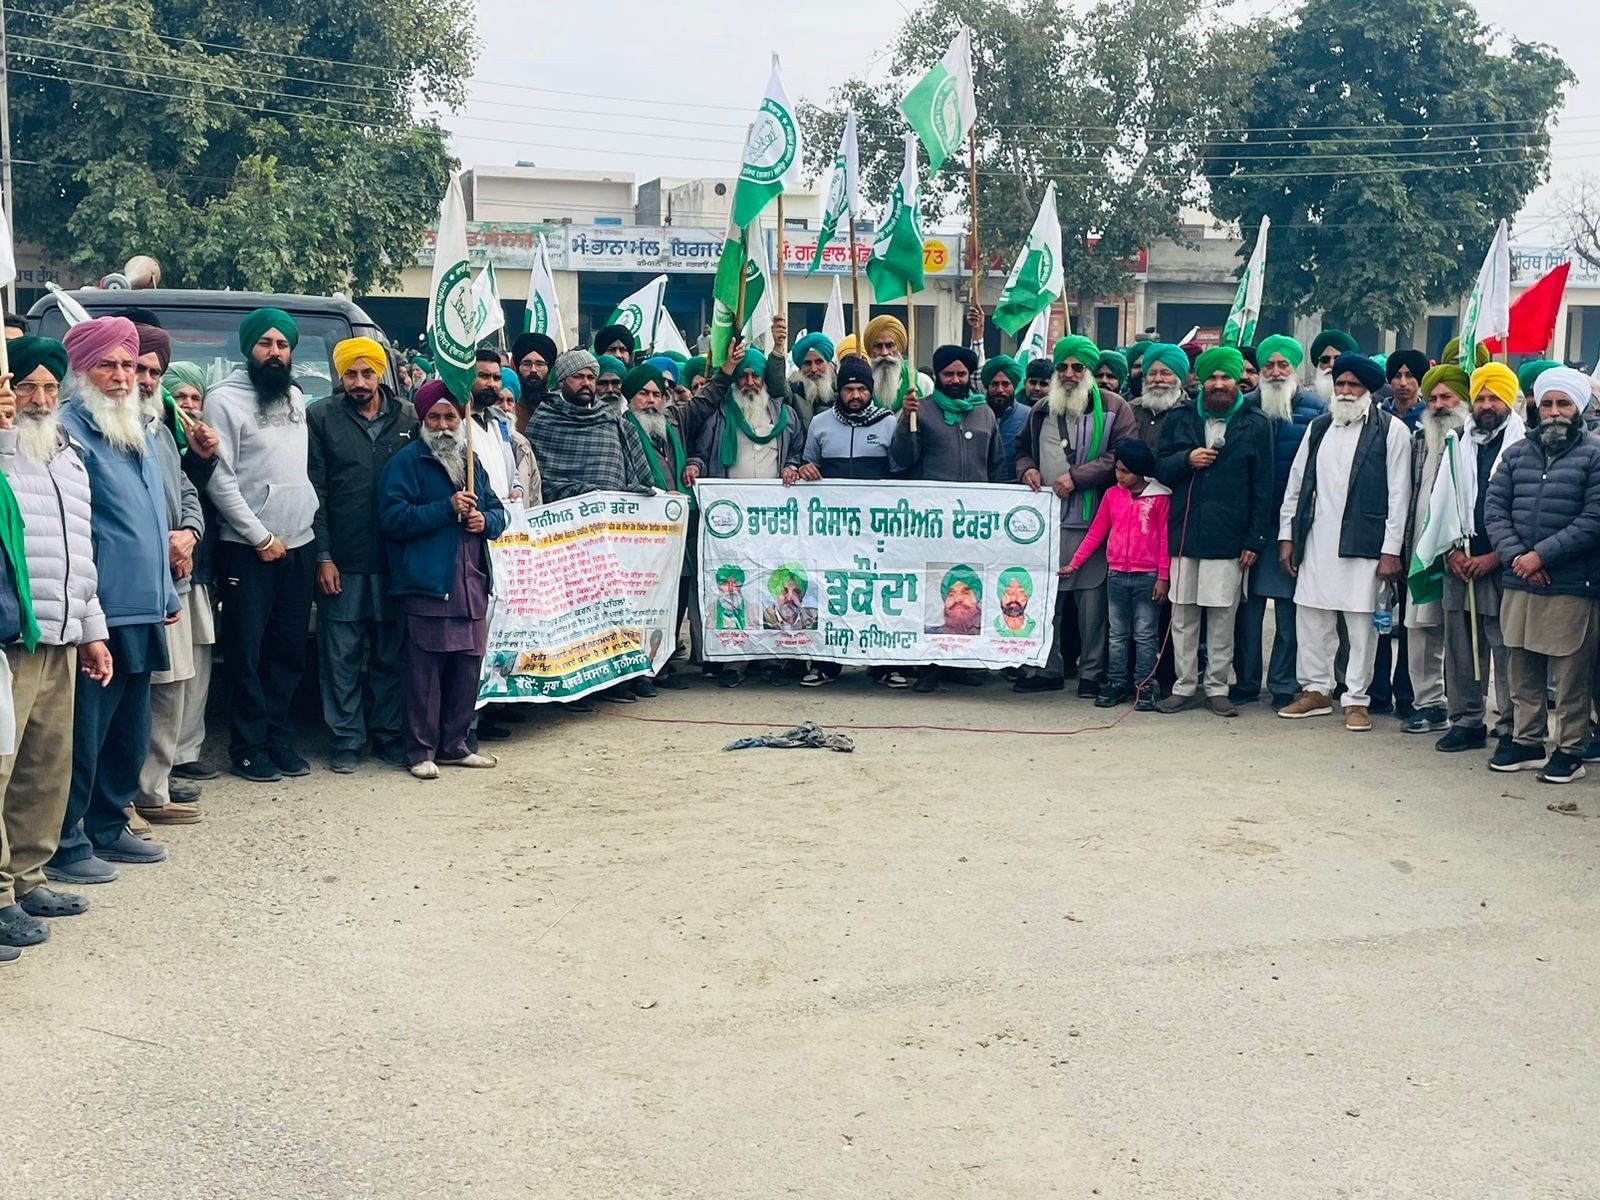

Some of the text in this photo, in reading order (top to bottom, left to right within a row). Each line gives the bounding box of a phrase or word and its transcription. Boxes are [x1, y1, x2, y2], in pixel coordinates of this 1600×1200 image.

[923, 249, 944, 265] 73
[747, 497, 1000, 552] ਭਾਰਤੀ ਕਿਸਾਨ ਯੂਨੀਅਨ ਏਕਤਾ
[824, 554, 918, 616] ਡਕੌਂਦਾ
[859, 624, 918, 653] ਲੁਧਿਆਣਾ
